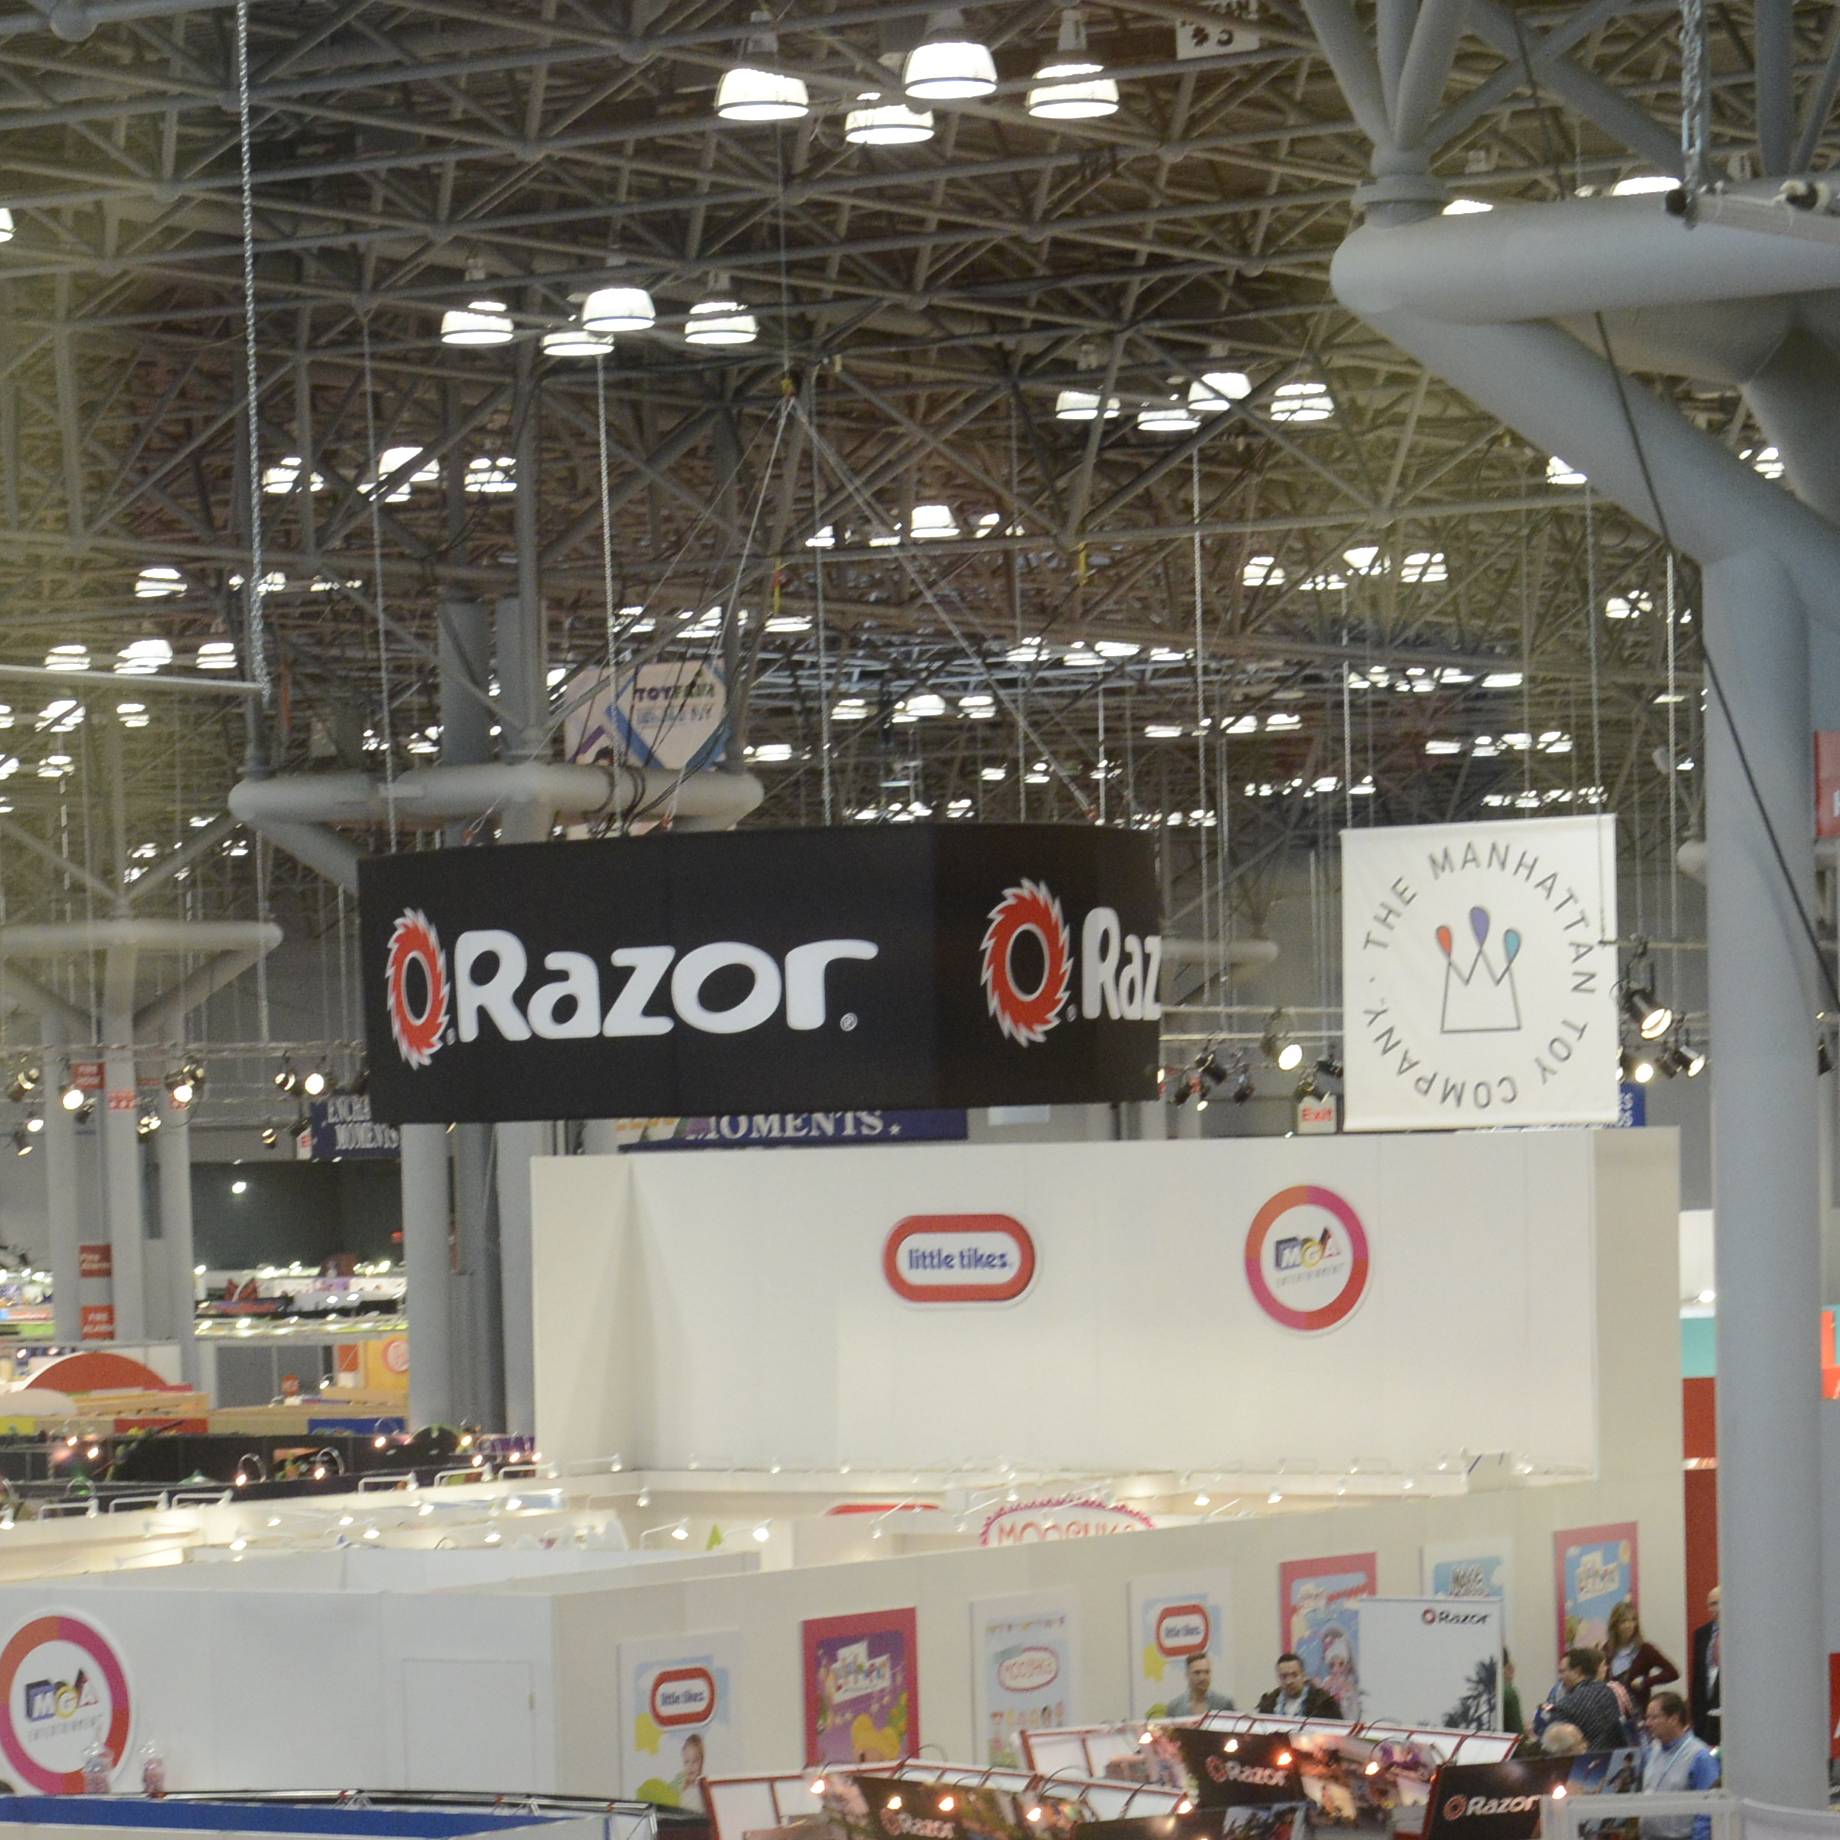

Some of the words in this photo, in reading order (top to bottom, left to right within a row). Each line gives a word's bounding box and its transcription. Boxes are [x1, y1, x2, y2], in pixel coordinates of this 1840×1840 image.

[1363, 876, 1418, 953] THE
[1429, 840, 1597, 994] MANHATTAN
[453, 929, 879, 1043] Razor
[1082, 906, 1160, 1021] Raz
[1363, 1002, 1518, 1109] COMPANY
[1536, 1020, 1588, 1084] TOY
[335, 1122, 400, 1150] MOMENTS
[1300, 1106, 1333, 1125] Exit
[908, 1248, 955, 1271] little
[957, 1248, 1008, 1271] tikes
[1439, 1610, 1489, 1625] Razor
[1466, 1793, 1542, 1816] Razor
